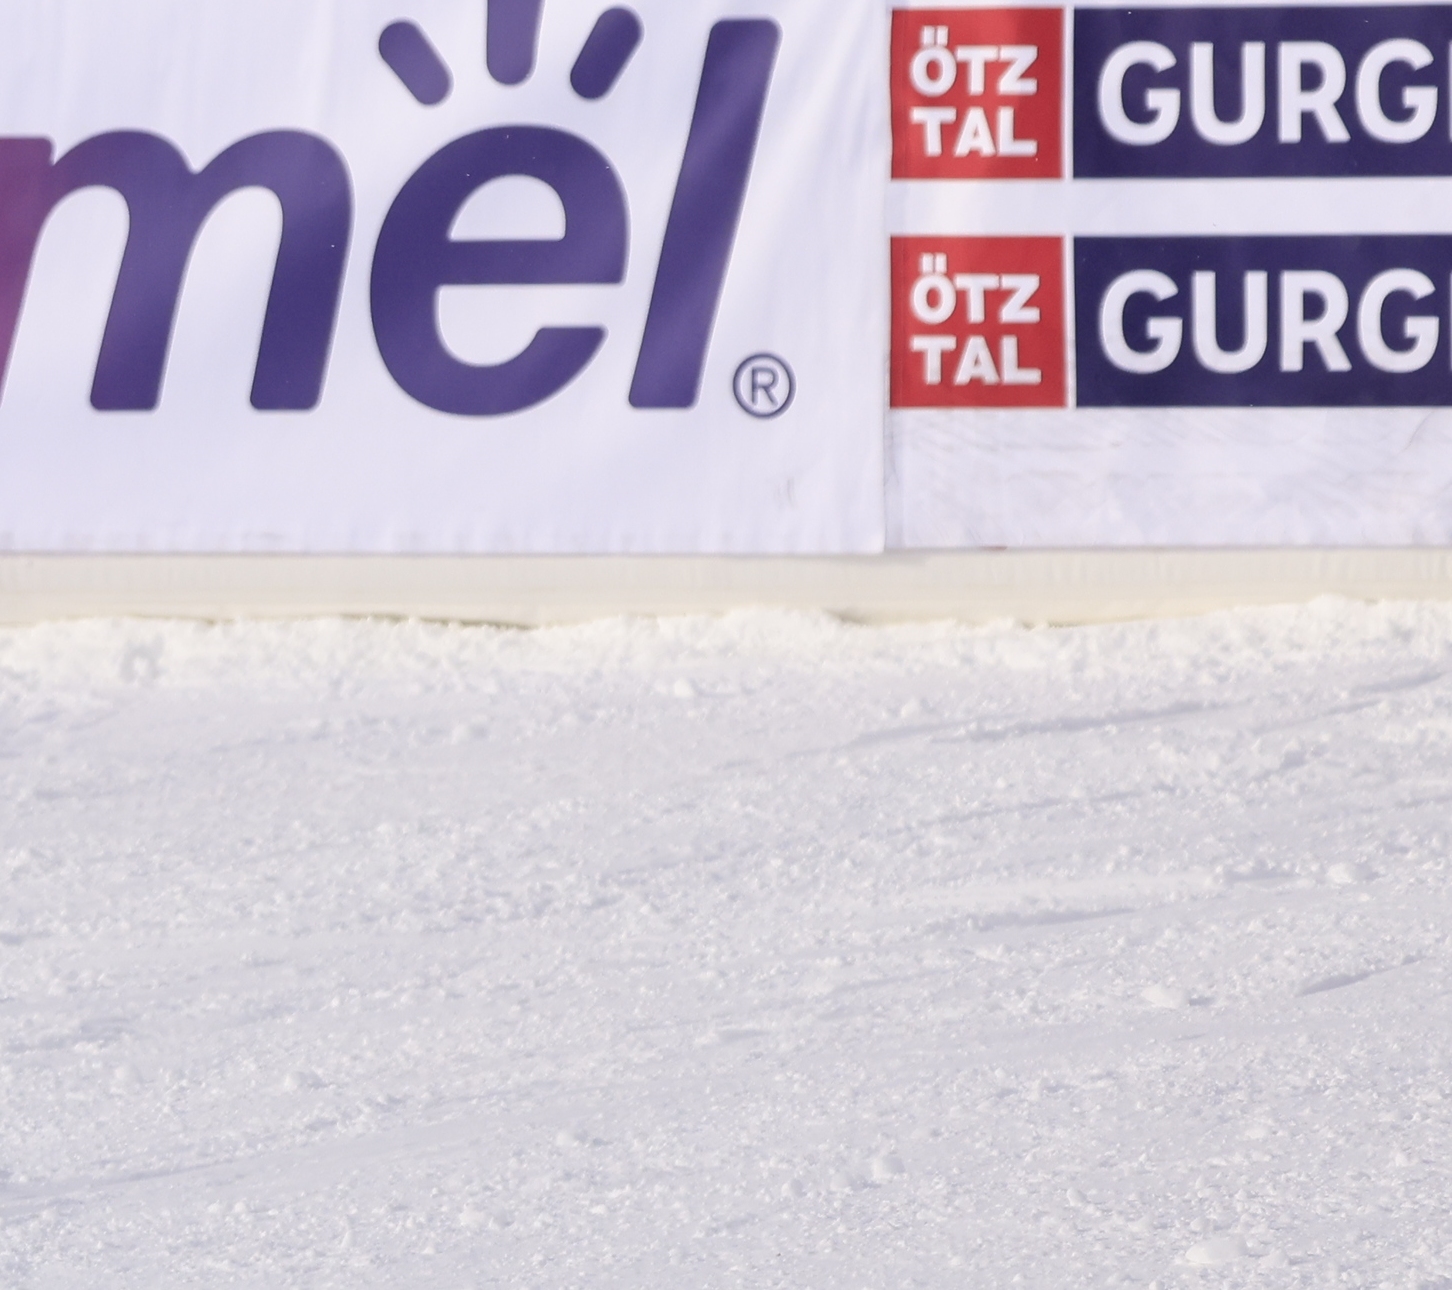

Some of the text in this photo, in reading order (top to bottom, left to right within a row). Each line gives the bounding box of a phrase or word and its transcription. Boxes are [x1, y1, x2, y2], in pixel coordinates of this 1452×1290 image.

[909, 26, 1039, 96] ÖTZ
[1097, 39, 1452, 146] GURG
[910, 107, 1038, 157] TAL
[911, 253, 1041, 324] ÖTZ
[1099, 268, 1452, 374] GURG
[910, 335, 1041, 385] TAL
